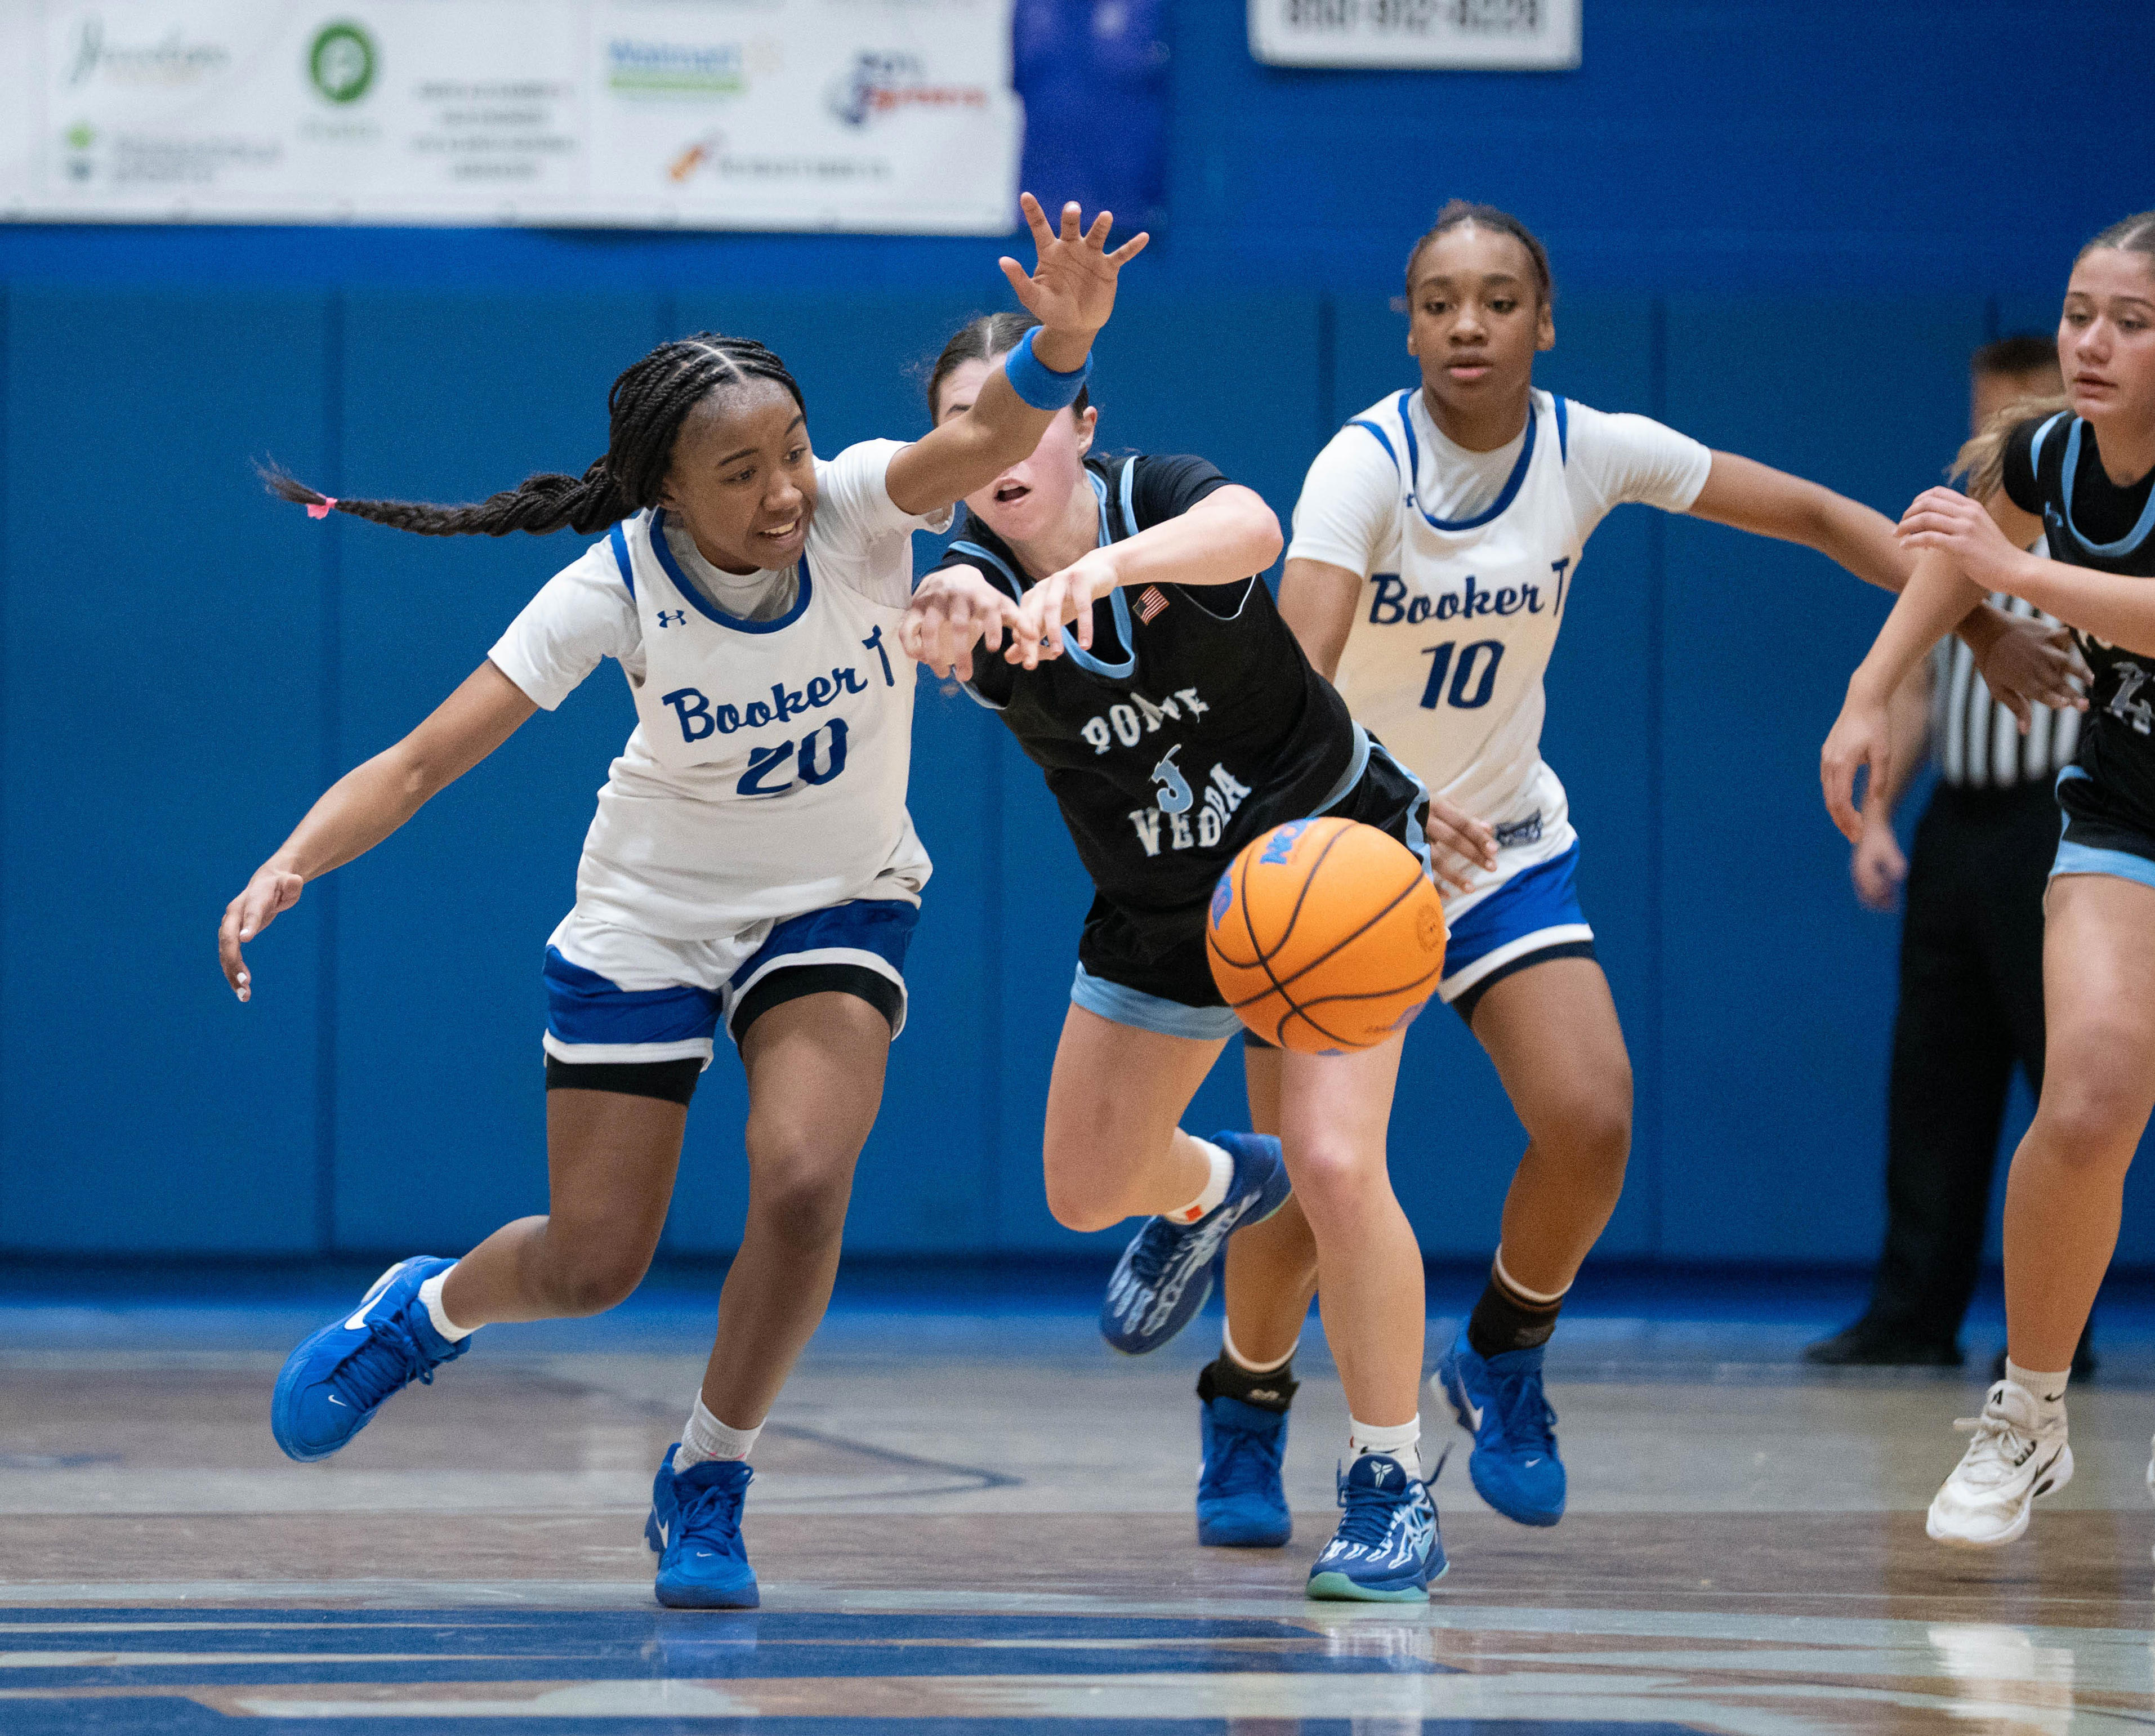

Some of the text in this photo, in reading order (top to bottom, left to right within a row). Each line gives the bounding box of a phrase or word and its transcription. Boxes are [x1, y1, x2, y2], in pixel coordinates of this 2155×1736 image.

[1368, 573, 1545, 625] Booker
[661, 667, 868, 743] Booker
[1420, 639, 1505, 710] 10
[736, 717, 850, 796] 20
